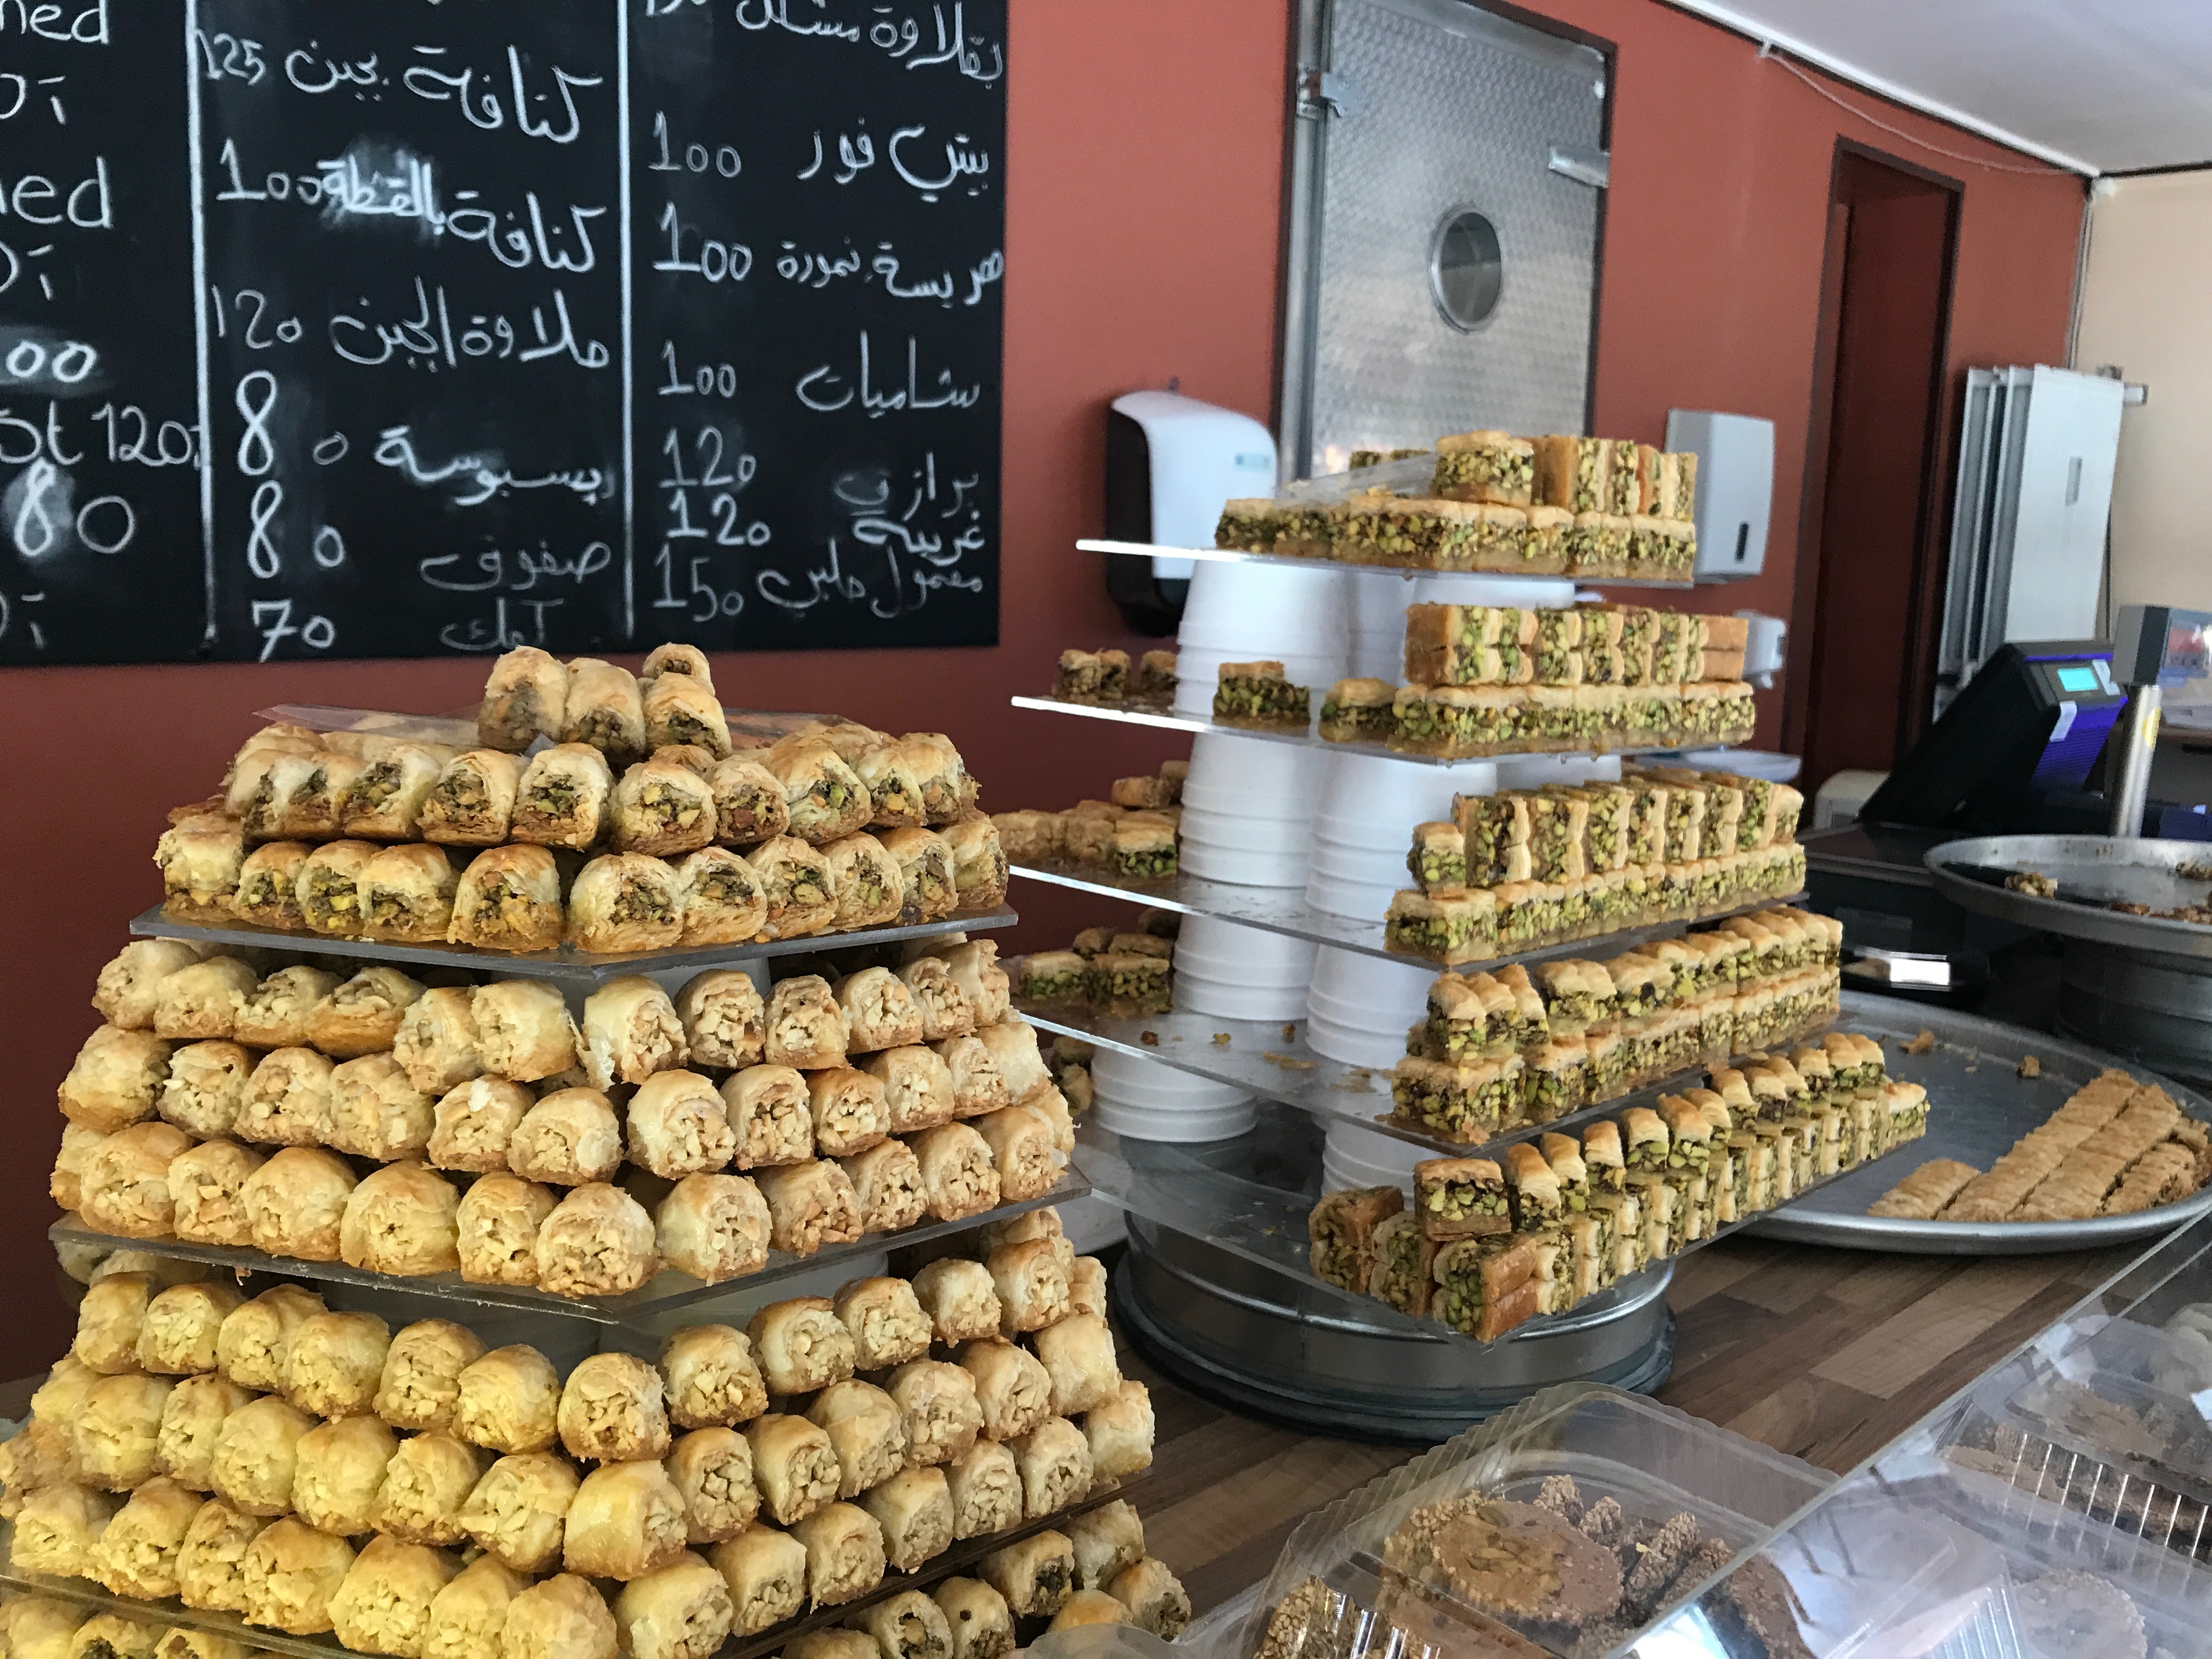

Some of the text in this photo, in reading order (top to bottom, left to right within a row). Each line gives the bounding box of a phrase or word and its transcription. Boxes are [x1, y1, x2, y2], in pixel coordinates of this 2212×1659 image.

[195, 29, 267, 86] 125
[216, 138, 321, 205] 100
[648, 111, 742, 178] 100
[653, 202, 753, 282] 100
[212, 284, 303, 349] 120
[658, 339, 737, 397] 100
[659, 427, 757, 488] 120
[247, 480, 345, 579] 80
[667, 489, 772, 546] 120
[652, 542, 745, 623] 150
[251, 598, 335, 664] 70
